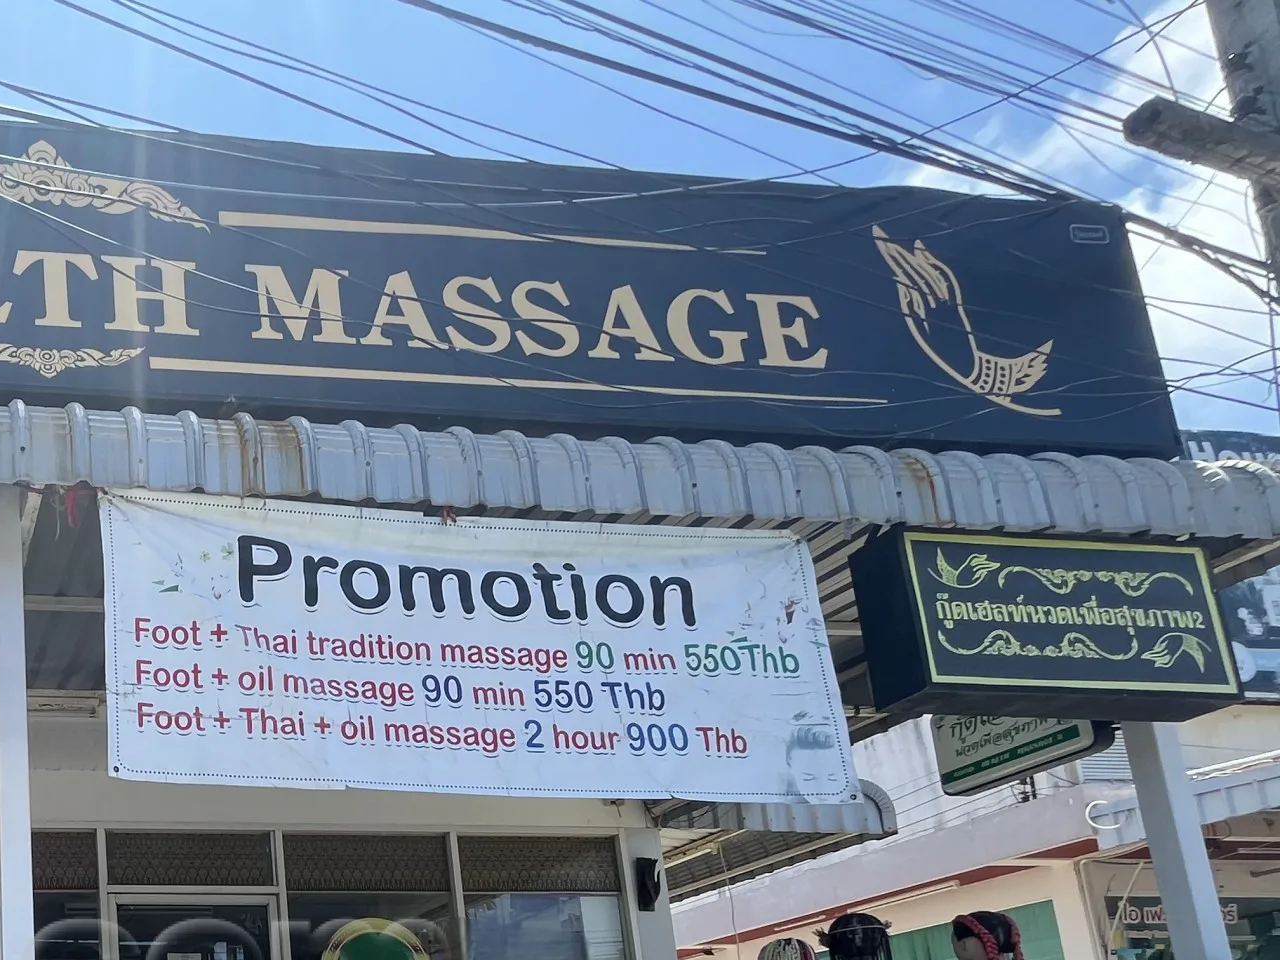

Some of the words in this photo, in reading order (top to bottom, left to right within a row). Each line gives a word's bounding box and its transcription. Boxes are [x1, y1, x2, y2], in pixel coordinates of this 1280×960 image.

[244, 263, 829, 373] MASSAGE
[238, 535, 698, 626] Promotion
[134, 617, 202, 648] Foot
[209, 623, 228, 642] +
[235, 623, 297, 655] Thai
[306, 630, 431, 663] tradition
[439, 643, 567, 673] massage
[576, 640, 614, 670] 90
[623, 648, 677, 672] min
[135, 659, 203, 691] Foot
[210, 668, 229, 686] +
[237, 664, 275, 694] oil
[282, 676, 415, 706] massage
[422, 674, 463, 705] 90
[472, 682, 525, 708] min
[533, 680, 594, 709] 550
[602, 682, 666, 712] Thb
[136, 702, 205, 733] Foot
[213, 710, 231, 728] +
[240, 707, 306, 737] Thai
[314, 716, 333, 735] +
[341, 712, 376, 742] oil
[384, 723, 516, 754] massage
[525, 721, 544, 748] 2
[553, 724, 619, 753] hour
[626, 724, 689, 752] 900
[697, 727, 749, 756] Thb
